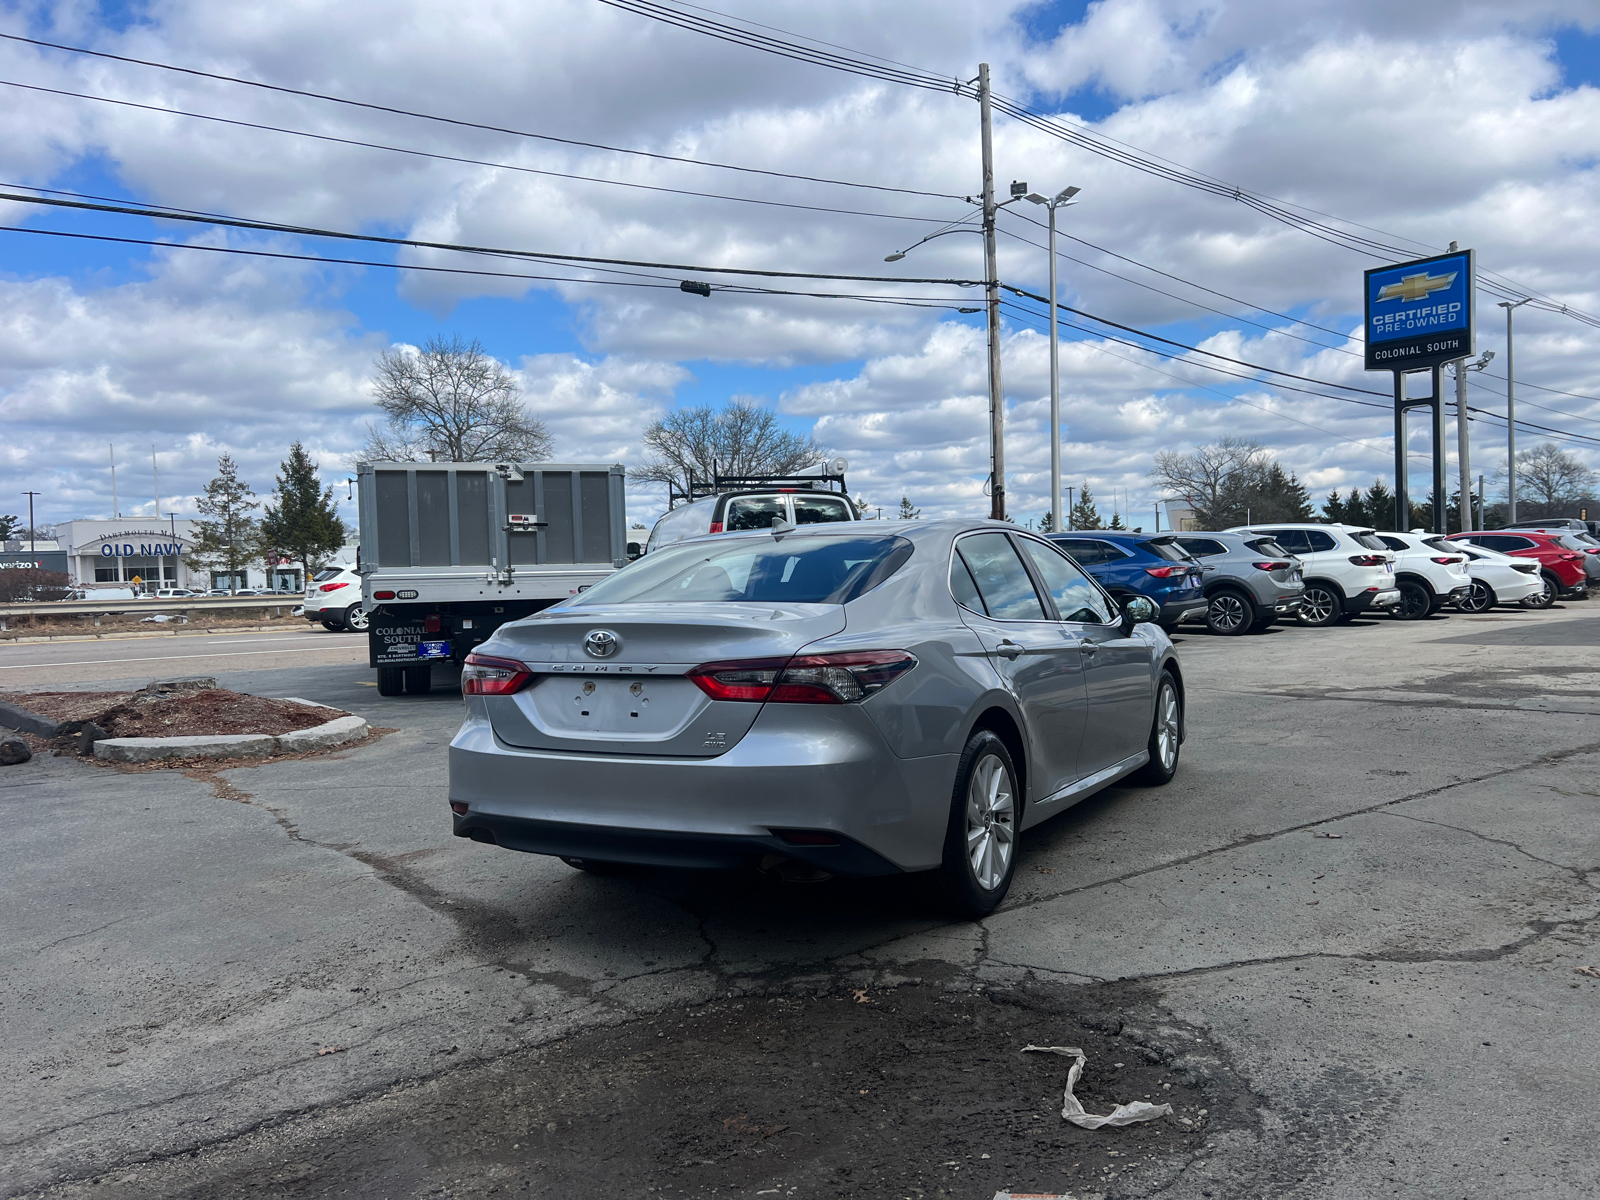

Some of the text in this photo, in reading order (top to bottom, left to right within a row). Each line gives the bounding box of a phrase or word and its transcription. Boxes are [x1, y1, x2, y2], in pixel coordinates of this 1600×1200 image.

[1372, 302, 1461, 325] CERTIFIED
[1376, 313, 1457, 334] PRE-OWNED
[1375, 339, 1459, 360] COLONIAL SOUTH
[101, 543, 184, 558] OLD NAVY
[375, 627, 428, 635] COLONIAL
[384, 635, 421, 643] SOUTH
[552, 664, 660, 673] CAMRY
[704, 732, 726, 740] LE
